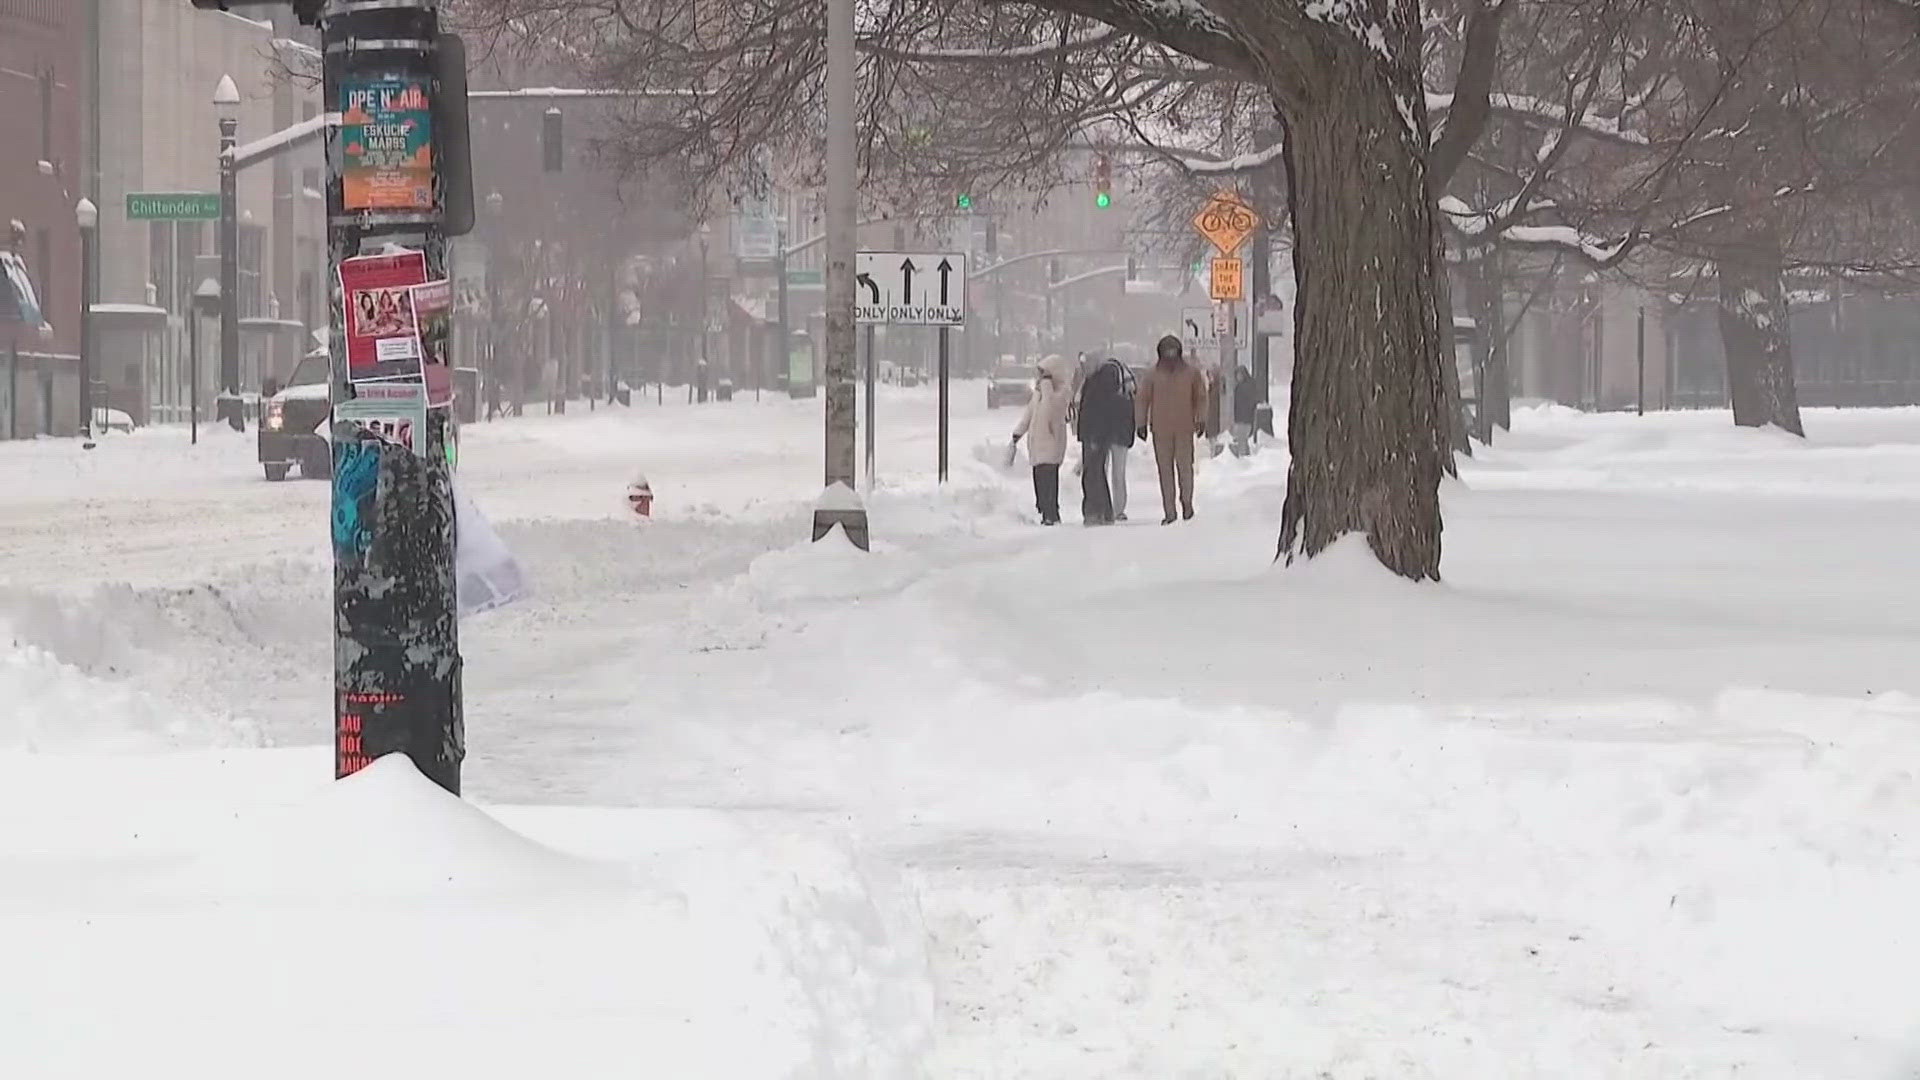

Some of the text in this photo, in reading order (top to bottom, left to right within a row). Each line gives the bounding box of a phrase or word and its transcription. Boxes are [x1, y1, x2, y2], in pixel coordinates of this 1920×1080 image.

[401, 89, 421, 108] AIR
[131, 200, 200, 215] Chittenden
[1215, 262, 1239, 271] SHARE
[1219, 275, 1233, 283] THE
[1216, 286, 1237, 295] ROAD
[855, 307, 959, 319] ONLY ONLY ONLY
